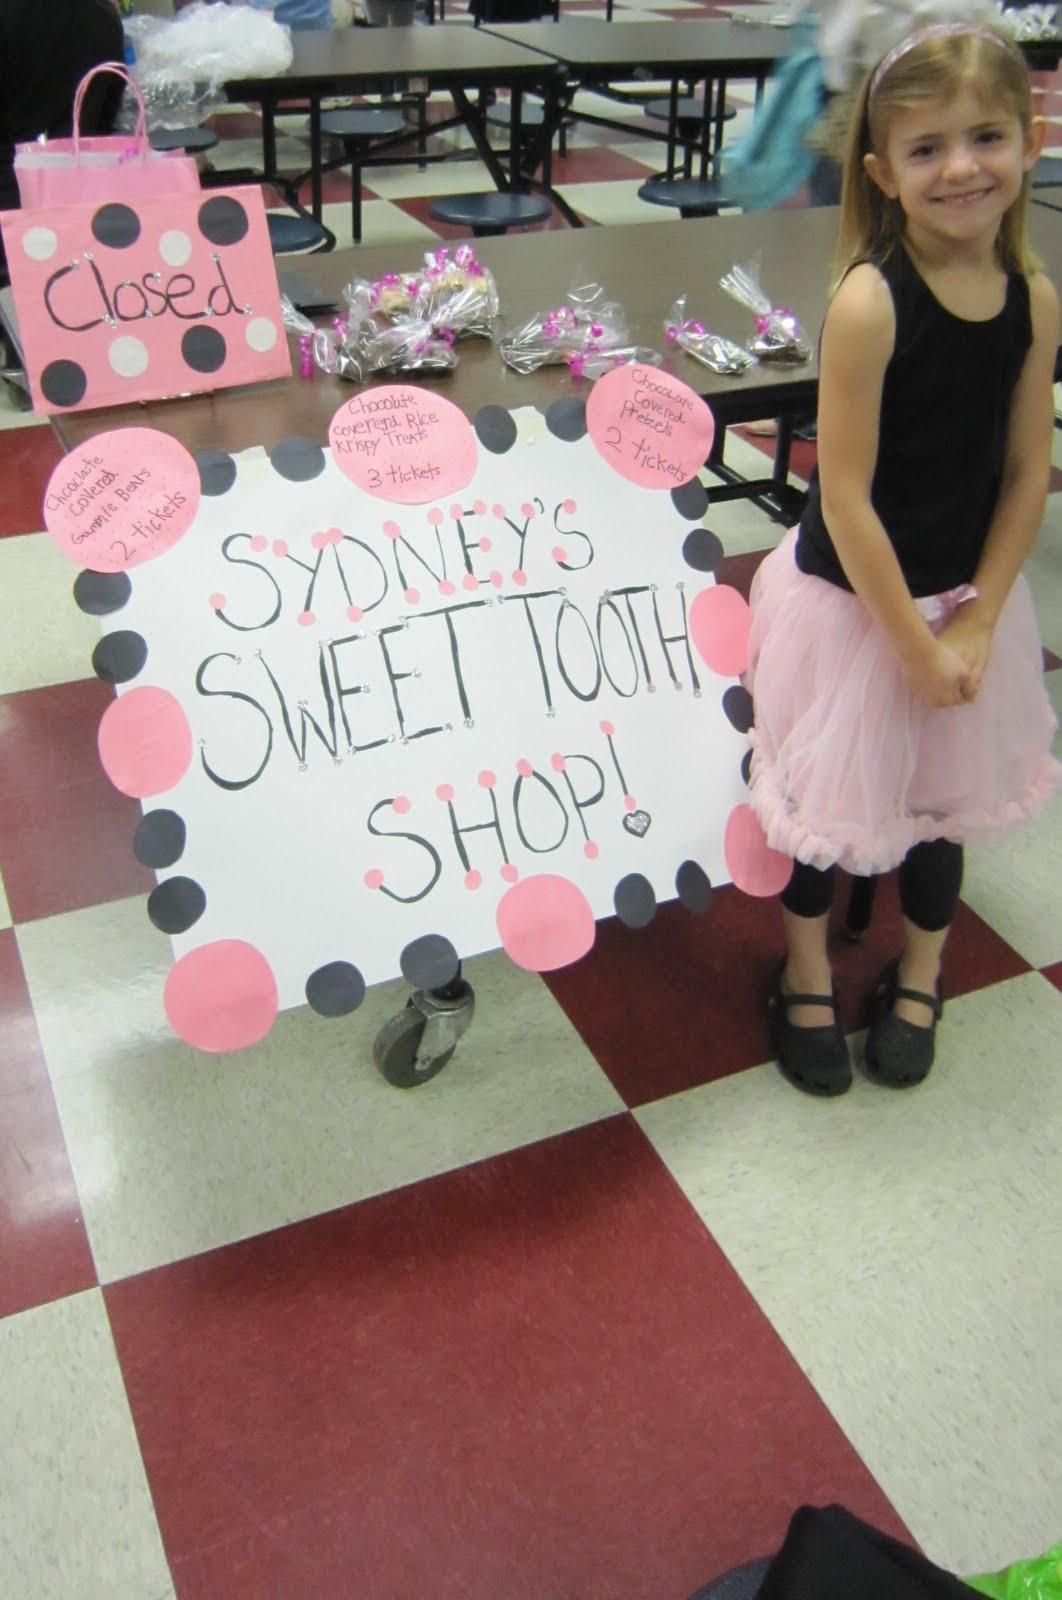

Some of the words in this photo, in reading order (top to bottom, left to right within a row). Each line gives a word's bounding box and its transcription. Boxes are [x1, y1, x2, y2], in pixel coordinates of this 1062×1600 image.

[44, 251, 253, 332] Closed
[348, 394, 418, 416] Chocolate
[406, 410, 439, 428] Rice
[620, 400, 673, 436] Pretzels
[634, 390, 685, 423] Covered
[367, 468, 382, 488] 3
[386, 463, 441, 484] tickets
[605, 426, 622, 453] 2
[632, 438, 688, 482] tickets
[110, 540, 136, 561] 2
[131, 491, 186, 539] tickets
[209, 497, 594, 631] SYDNEY'S
[195, 599, 494, 790] SWEET
[496, 582, 703, 719] TOOTH
[364, 720, 652, 903] SHOP!
